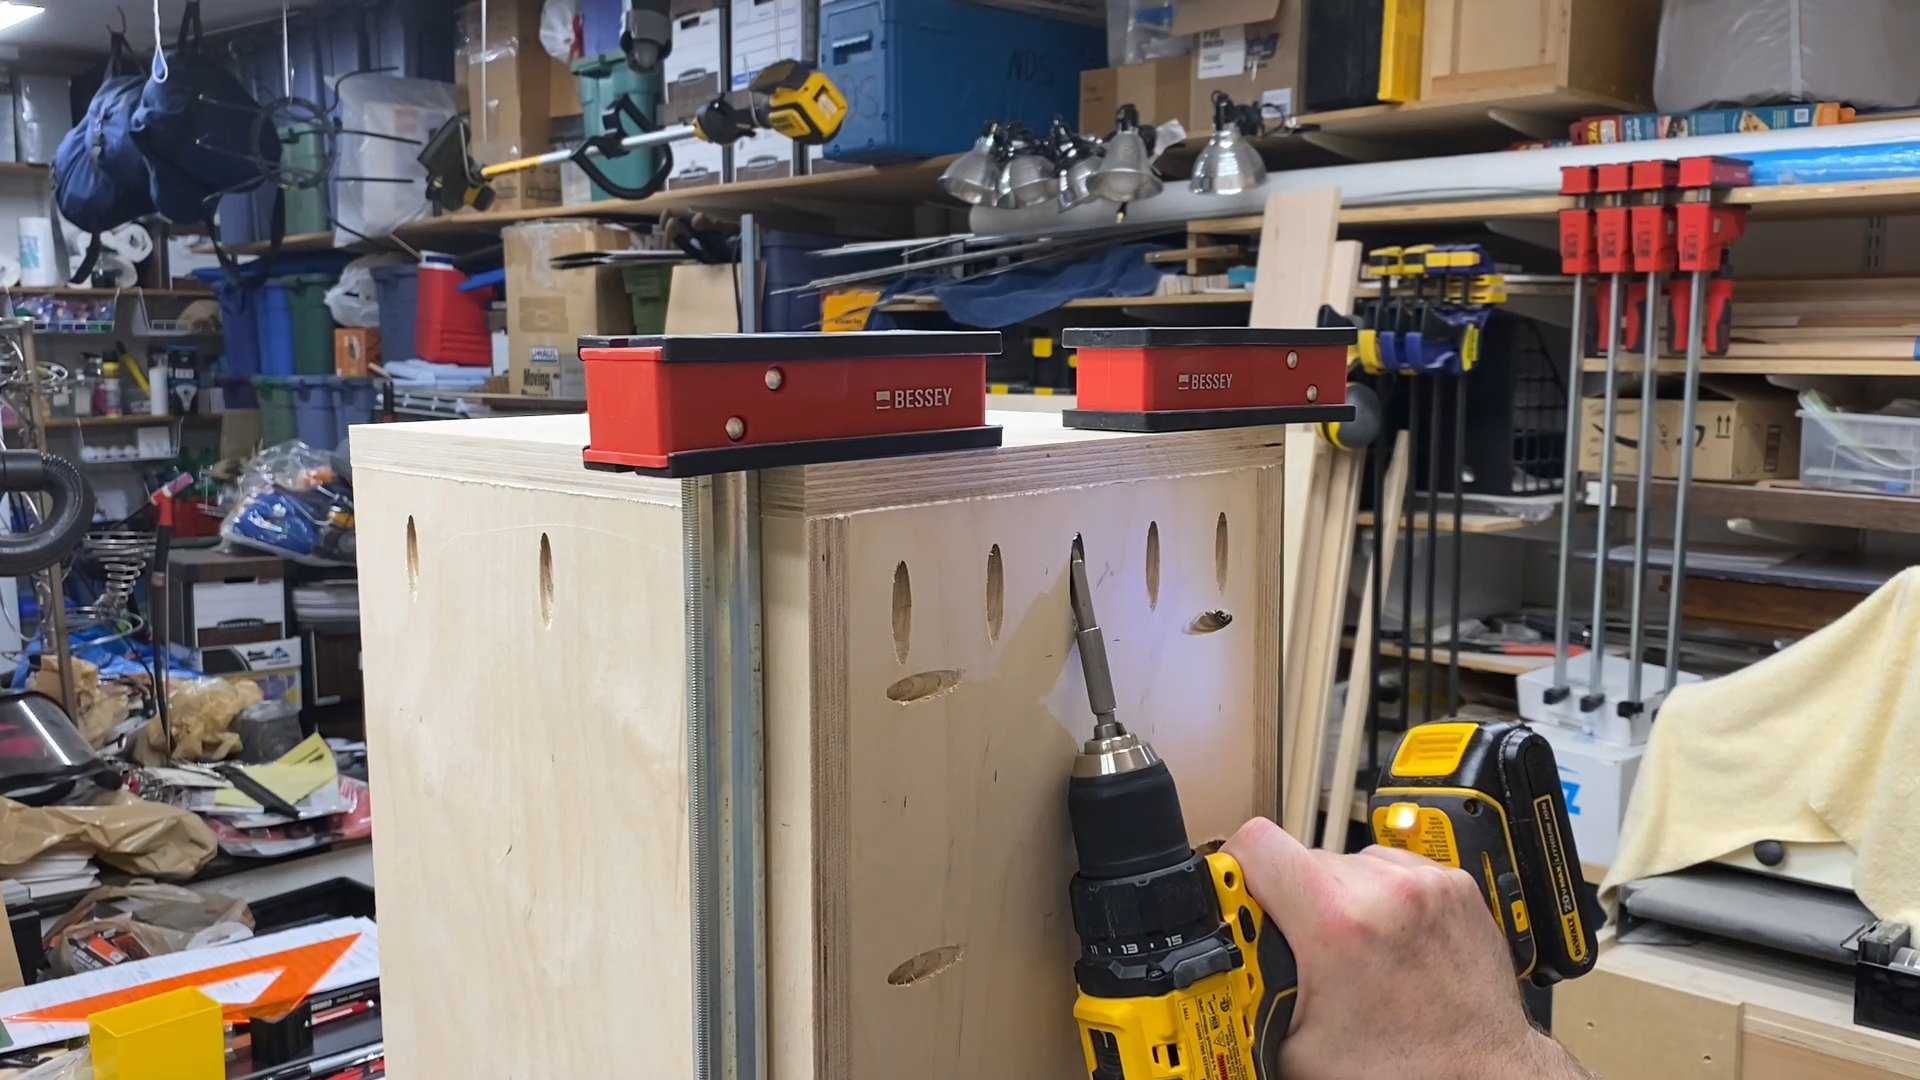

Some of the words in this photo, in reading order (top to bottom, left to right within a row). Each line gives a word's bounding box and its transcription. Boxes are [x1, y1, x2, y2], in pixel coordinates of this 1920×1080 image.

[523, 368, 550, 391] Moving
[1191, 374, 1233, 390] BESSEY
[894, 388, 952, 409] BESSEY
[1121, 943, 1139, 955] 13
[1165, 934, 1183, 948] 15
